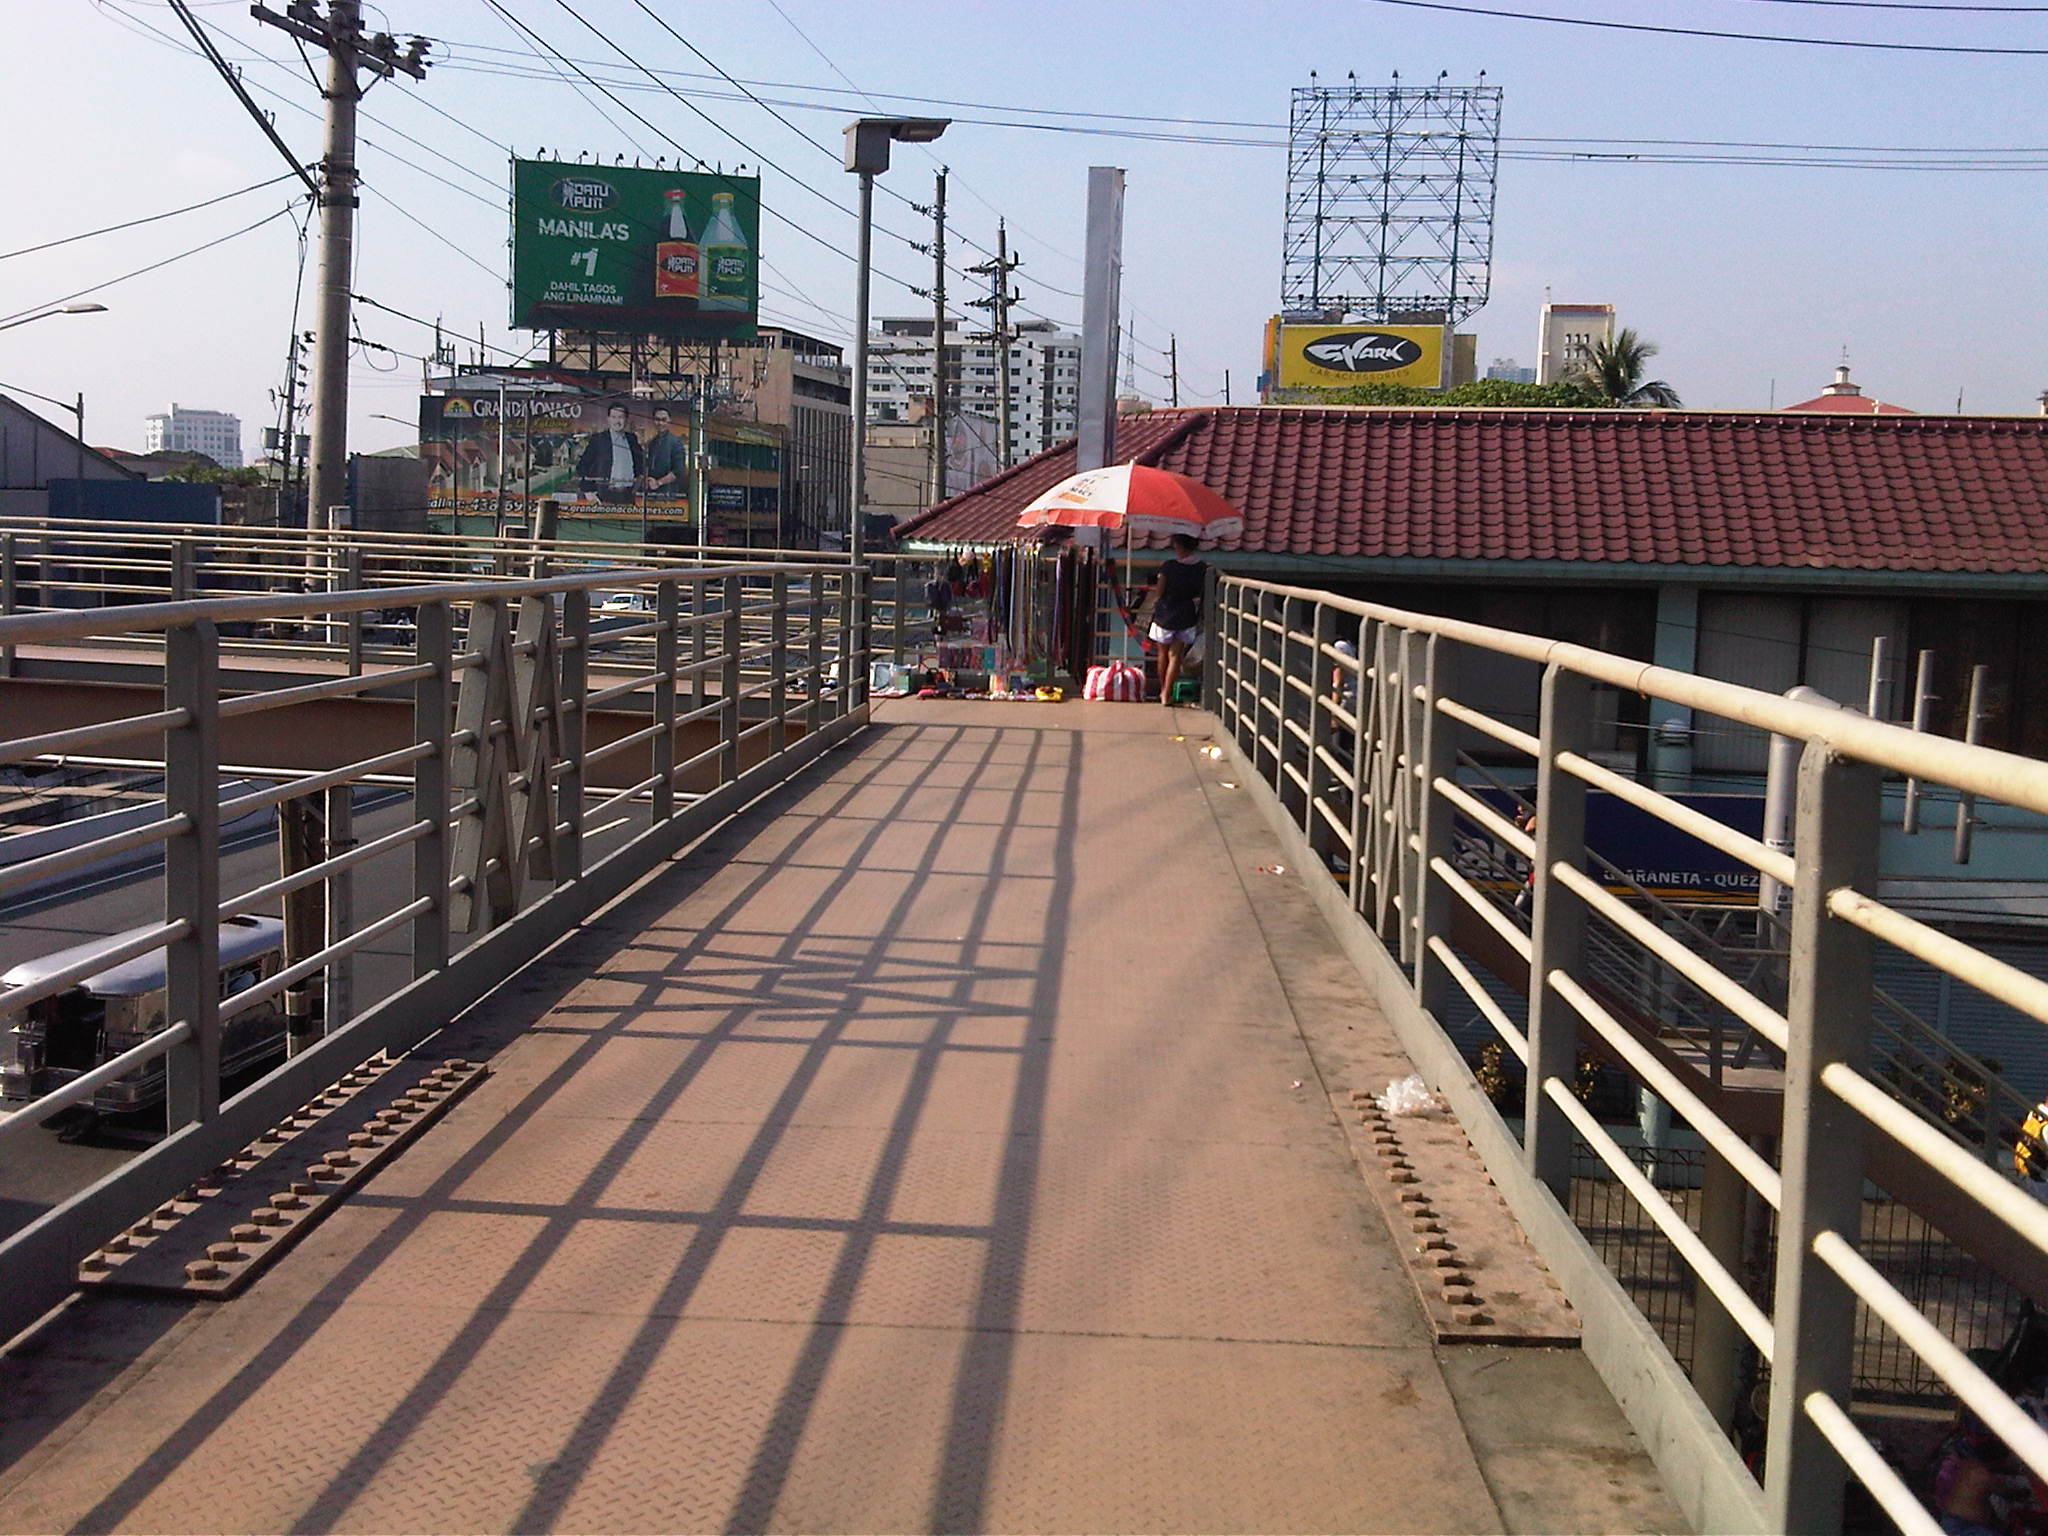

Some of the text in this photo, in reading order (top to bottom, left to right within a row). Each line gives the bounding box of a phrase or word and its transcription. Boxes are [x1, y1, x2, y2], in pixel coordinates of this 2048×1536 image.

[573, 183, 609, 197] DATU
[573, 196, 603, 209] PUTI
[538, 218, 630, 242] MANILA'S
[570, 247, 599, 277] #1
[550, 281, 616, 294] DAHIL TAGOS
[543, 291, 568, 302] ANG
[1306, 336, 1408, 371] SHARK
[1310, 366, 1411, 382] CAR ACCESSORIES
